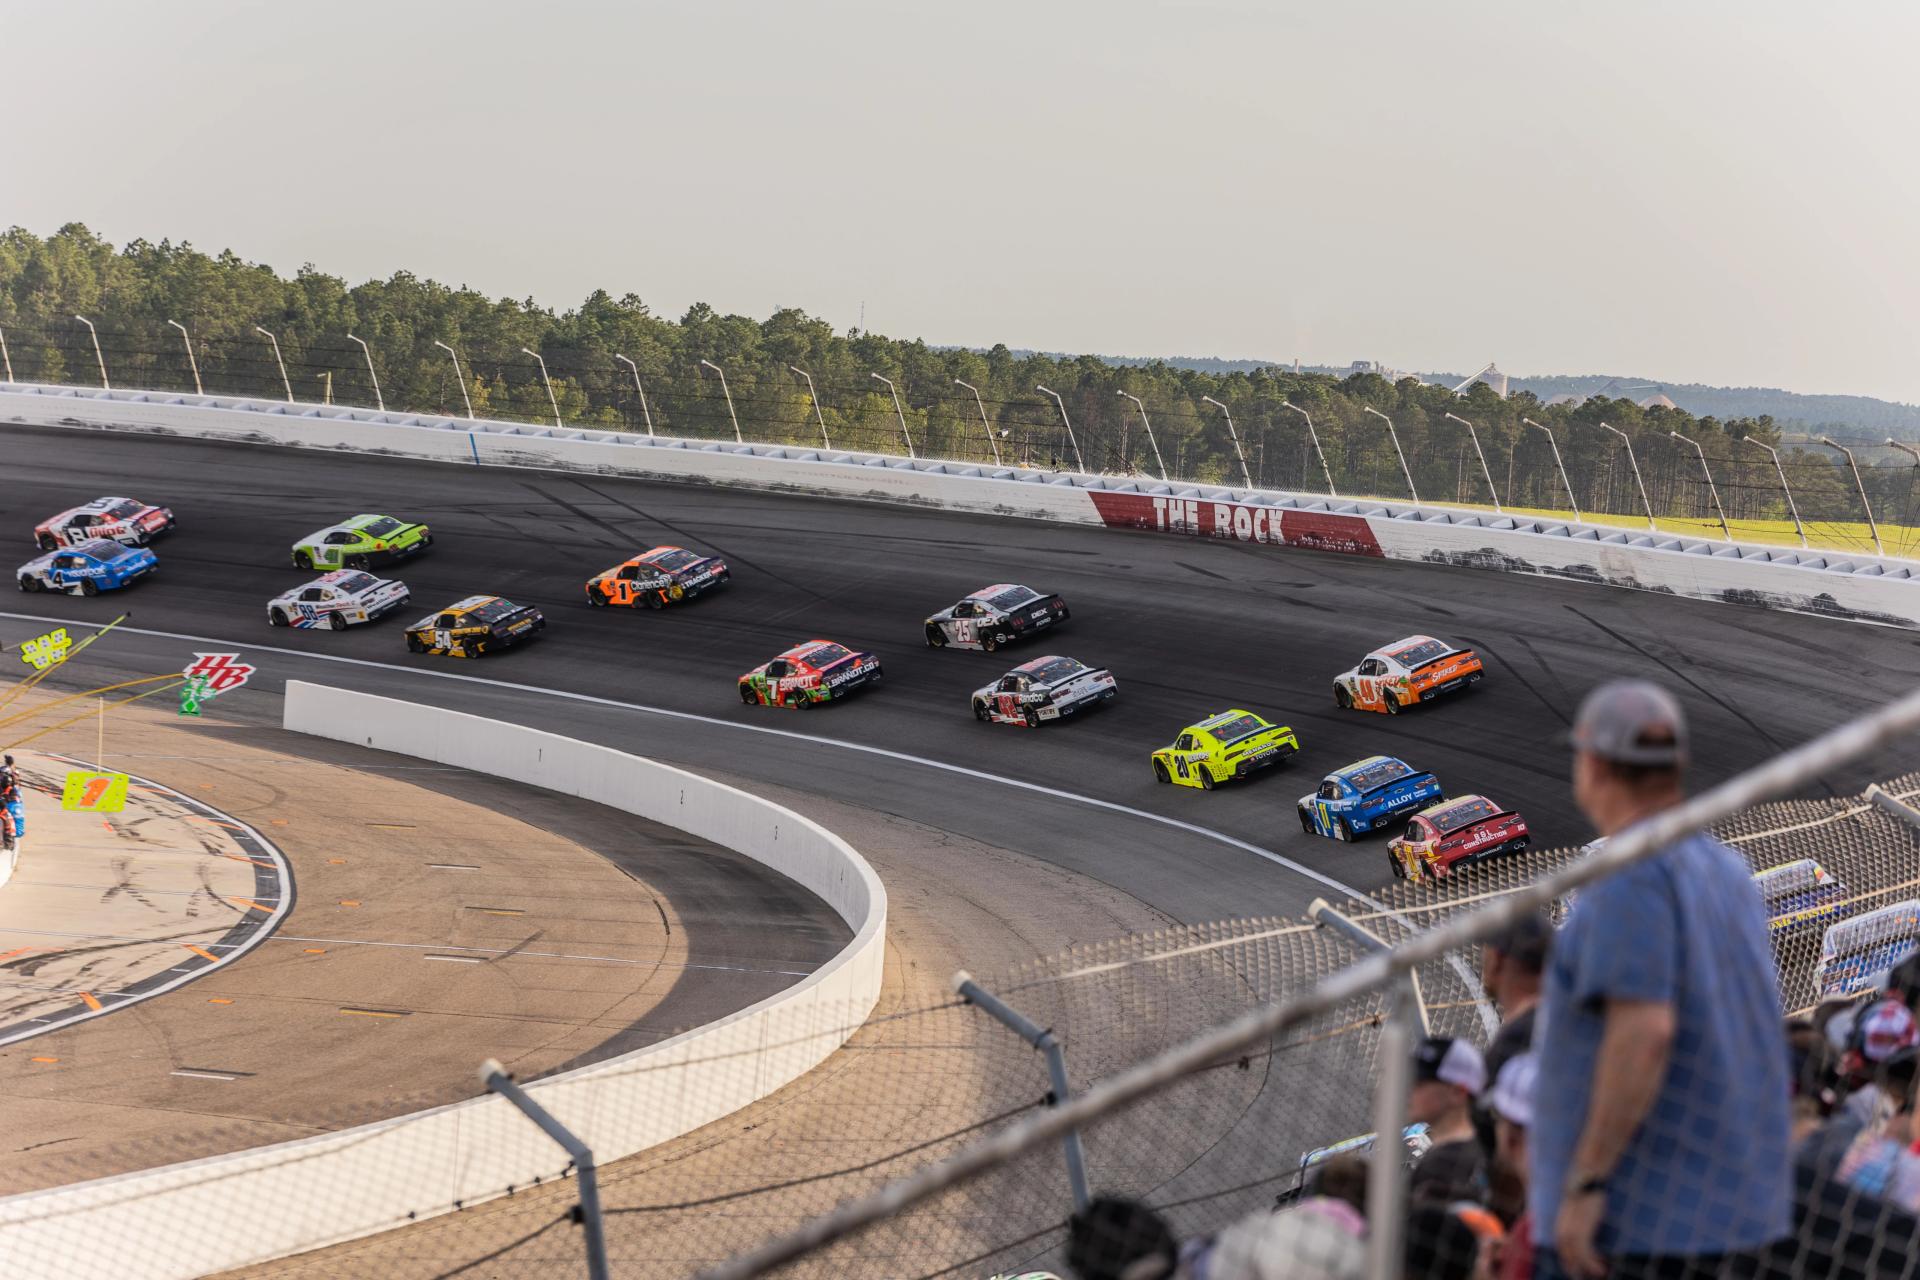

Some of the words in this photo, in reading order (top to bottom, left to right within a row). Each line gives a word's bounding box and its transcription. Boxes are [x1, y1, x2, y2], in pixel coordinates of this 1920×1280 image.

[1153, 498, 1199, 535] THE
[1214, 503, 1286, 545] ROCK
[53, 570, 65, 589] 4
[618, 583, 627, 600] 1
[299, 605, 318, 620] 88
[1031, 608, 1048, 619] DEX
[955, 621, 971, 642] 25
[977, 617, 1000, 628] DEX
[434, 631, 450, 649] 54
[766, 680, 778, 700] 7
[780, 675, 817, 692] BRANDT
[1255, 748, 1278, 760] TOYOTA
[1174, 755, 1190, 779] 20
[79, 777, 112, 807] 1
[1388, 793, 1413, 808] ALLOY
[1463, 830, 1508, 850] CONSTRUCTION
